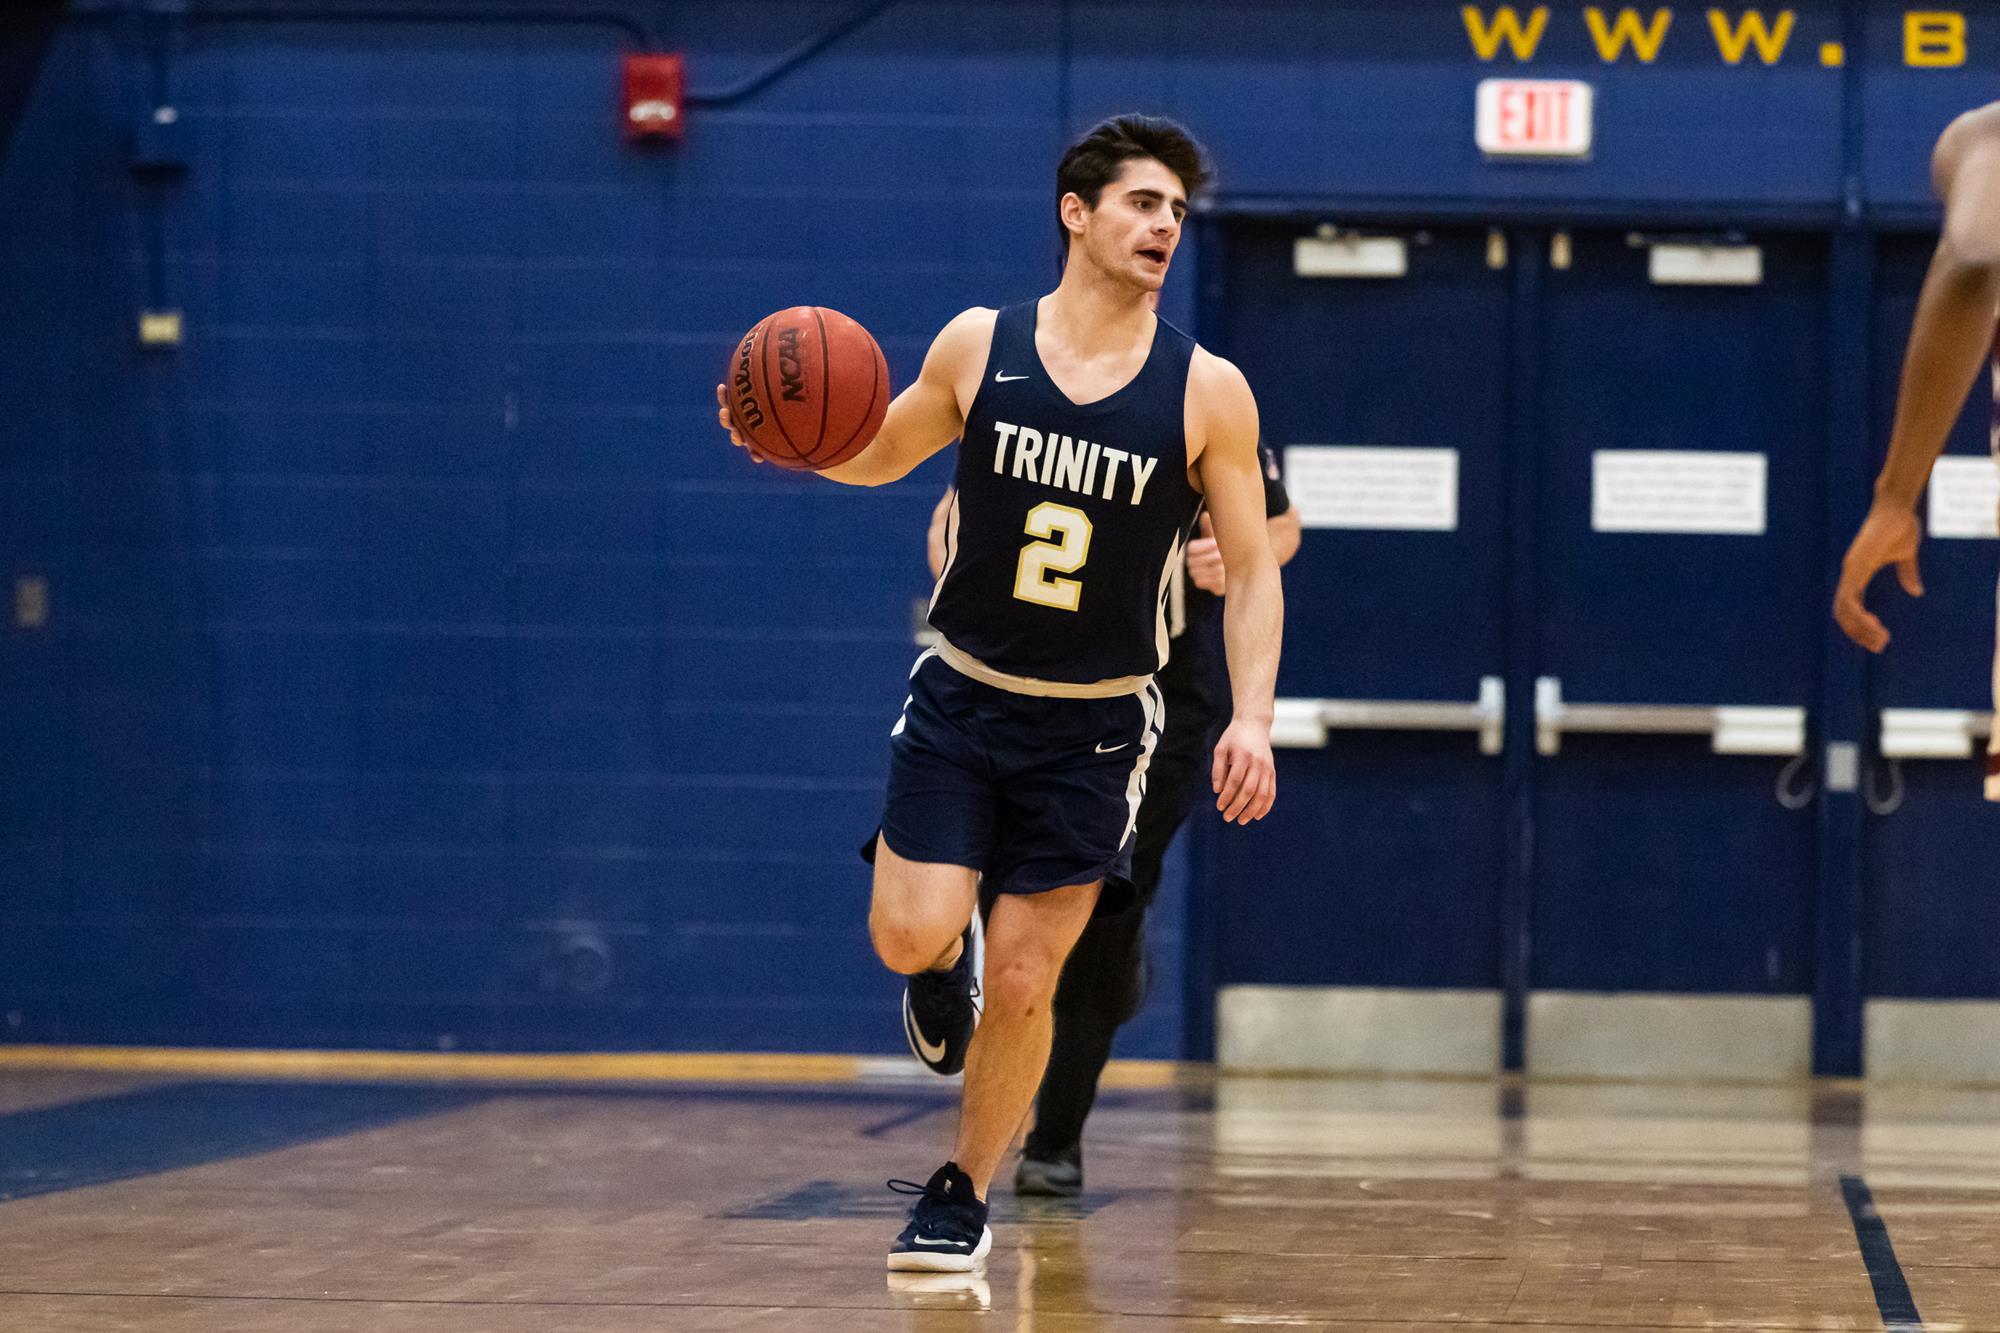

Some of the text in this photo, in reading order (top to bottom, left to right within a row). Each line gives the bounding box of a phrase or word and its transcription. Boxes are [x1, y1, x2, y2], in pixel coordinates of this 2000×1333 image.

[1498, 82, 1572, 150] EXIT
[778, 327, 805, 402] NCAA
[993, 421, 1158, 505] TRINITY
[1012, 501, 1094, 612] 2
